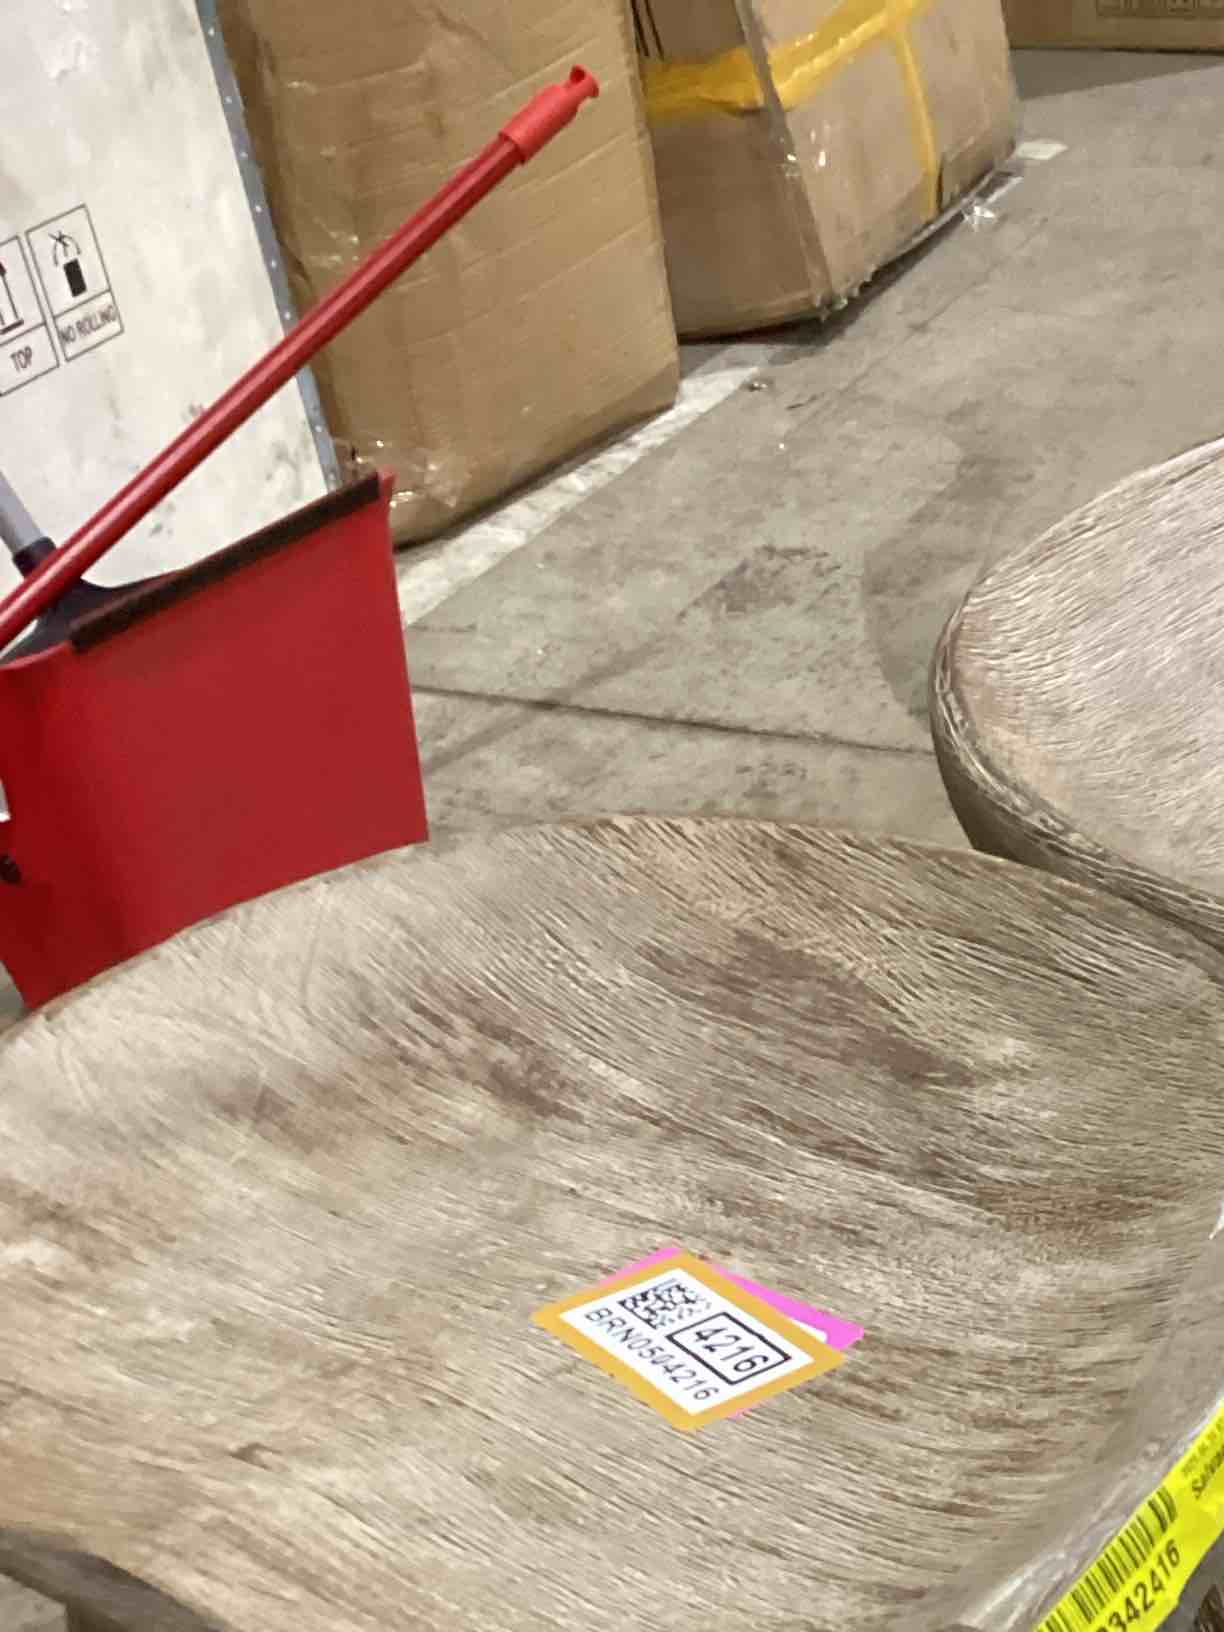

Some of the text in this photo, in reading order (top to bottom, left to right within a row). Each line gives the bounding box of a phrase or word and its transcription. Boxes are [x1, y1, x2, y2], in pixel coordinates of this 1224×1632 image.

[59, 305, 117, 344] NO ROLLING
[10, 346, 33, 372] TOP
[584, 1307, 720, 1401] BRN0504216
[694, 1324, 769, 1373] 4216
